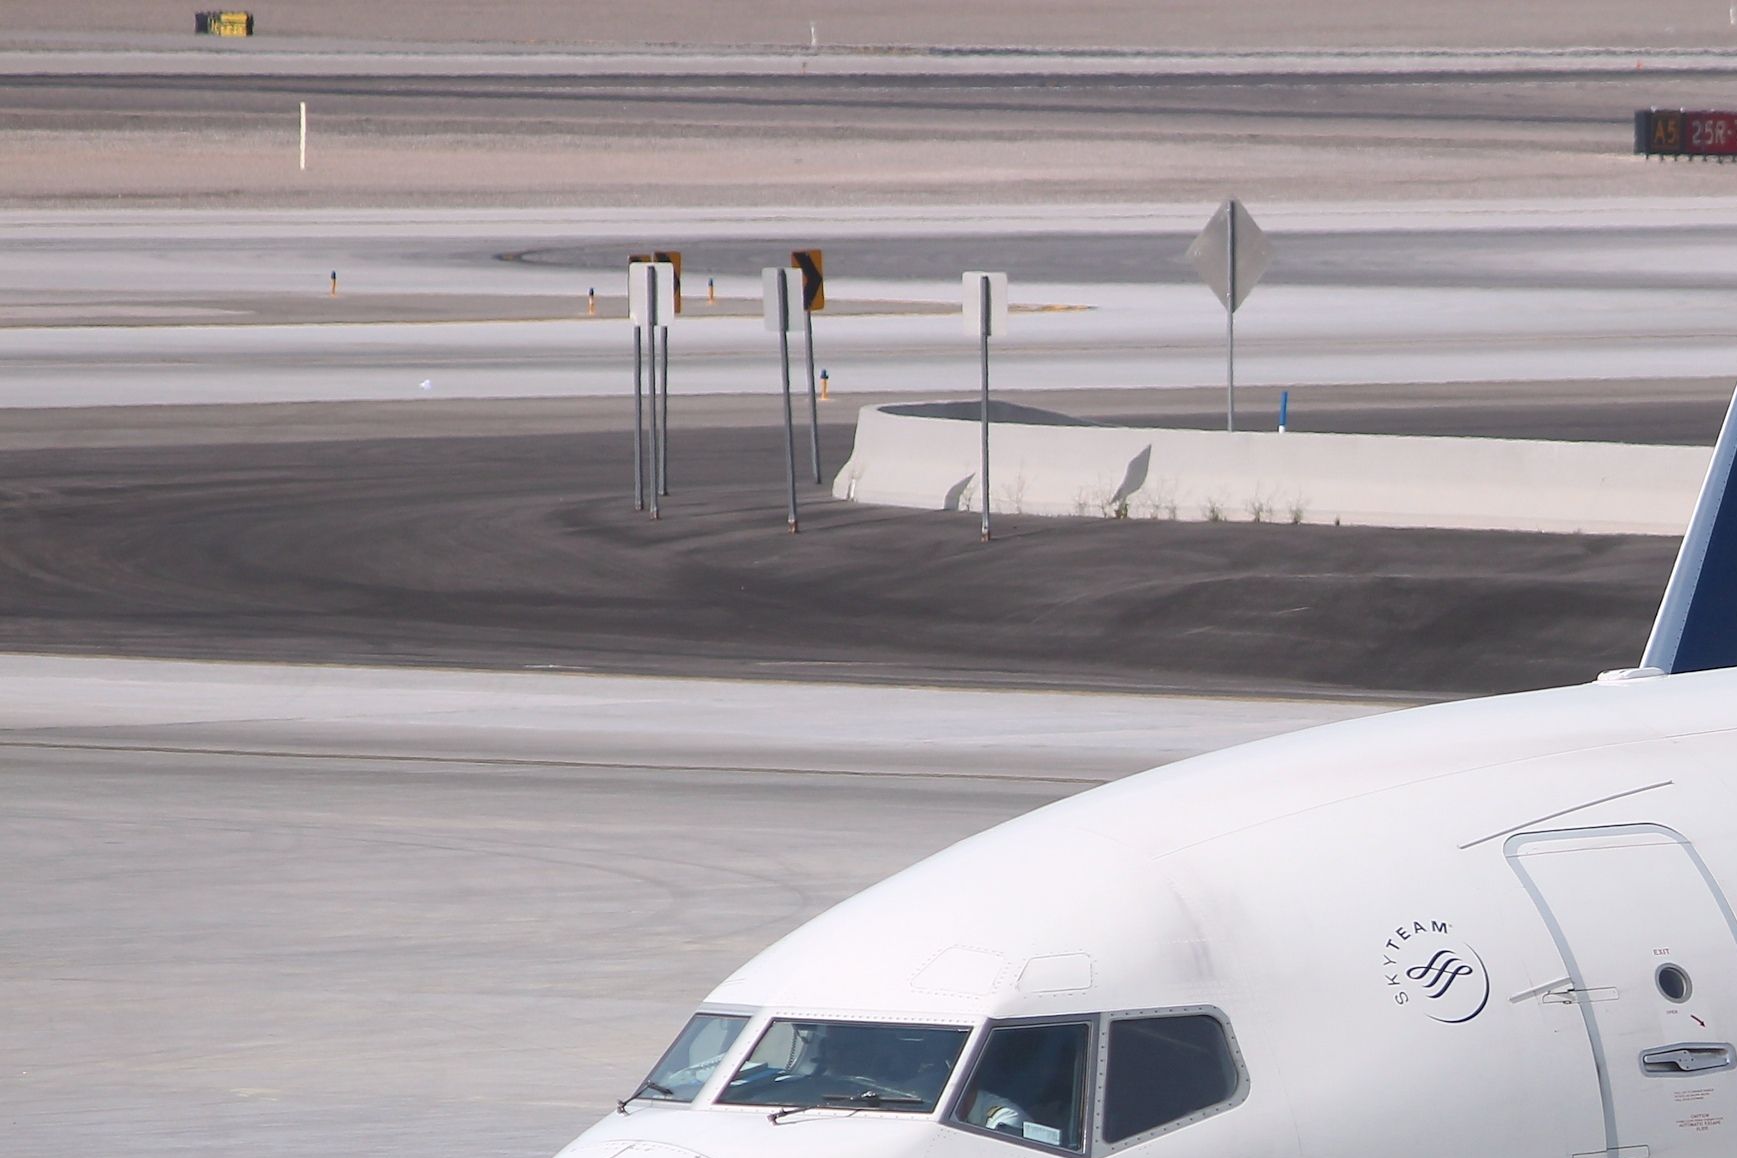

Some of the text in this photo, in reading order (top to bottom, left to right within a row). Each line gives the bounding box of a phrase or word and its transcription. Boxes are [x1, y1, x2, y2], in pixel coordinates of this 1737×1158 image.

[1654, 119, 1678, 144] A5
[1383, 920, 1448, 1005] SKYTEAM
[1653, 948, 1670, 956] EXIT
